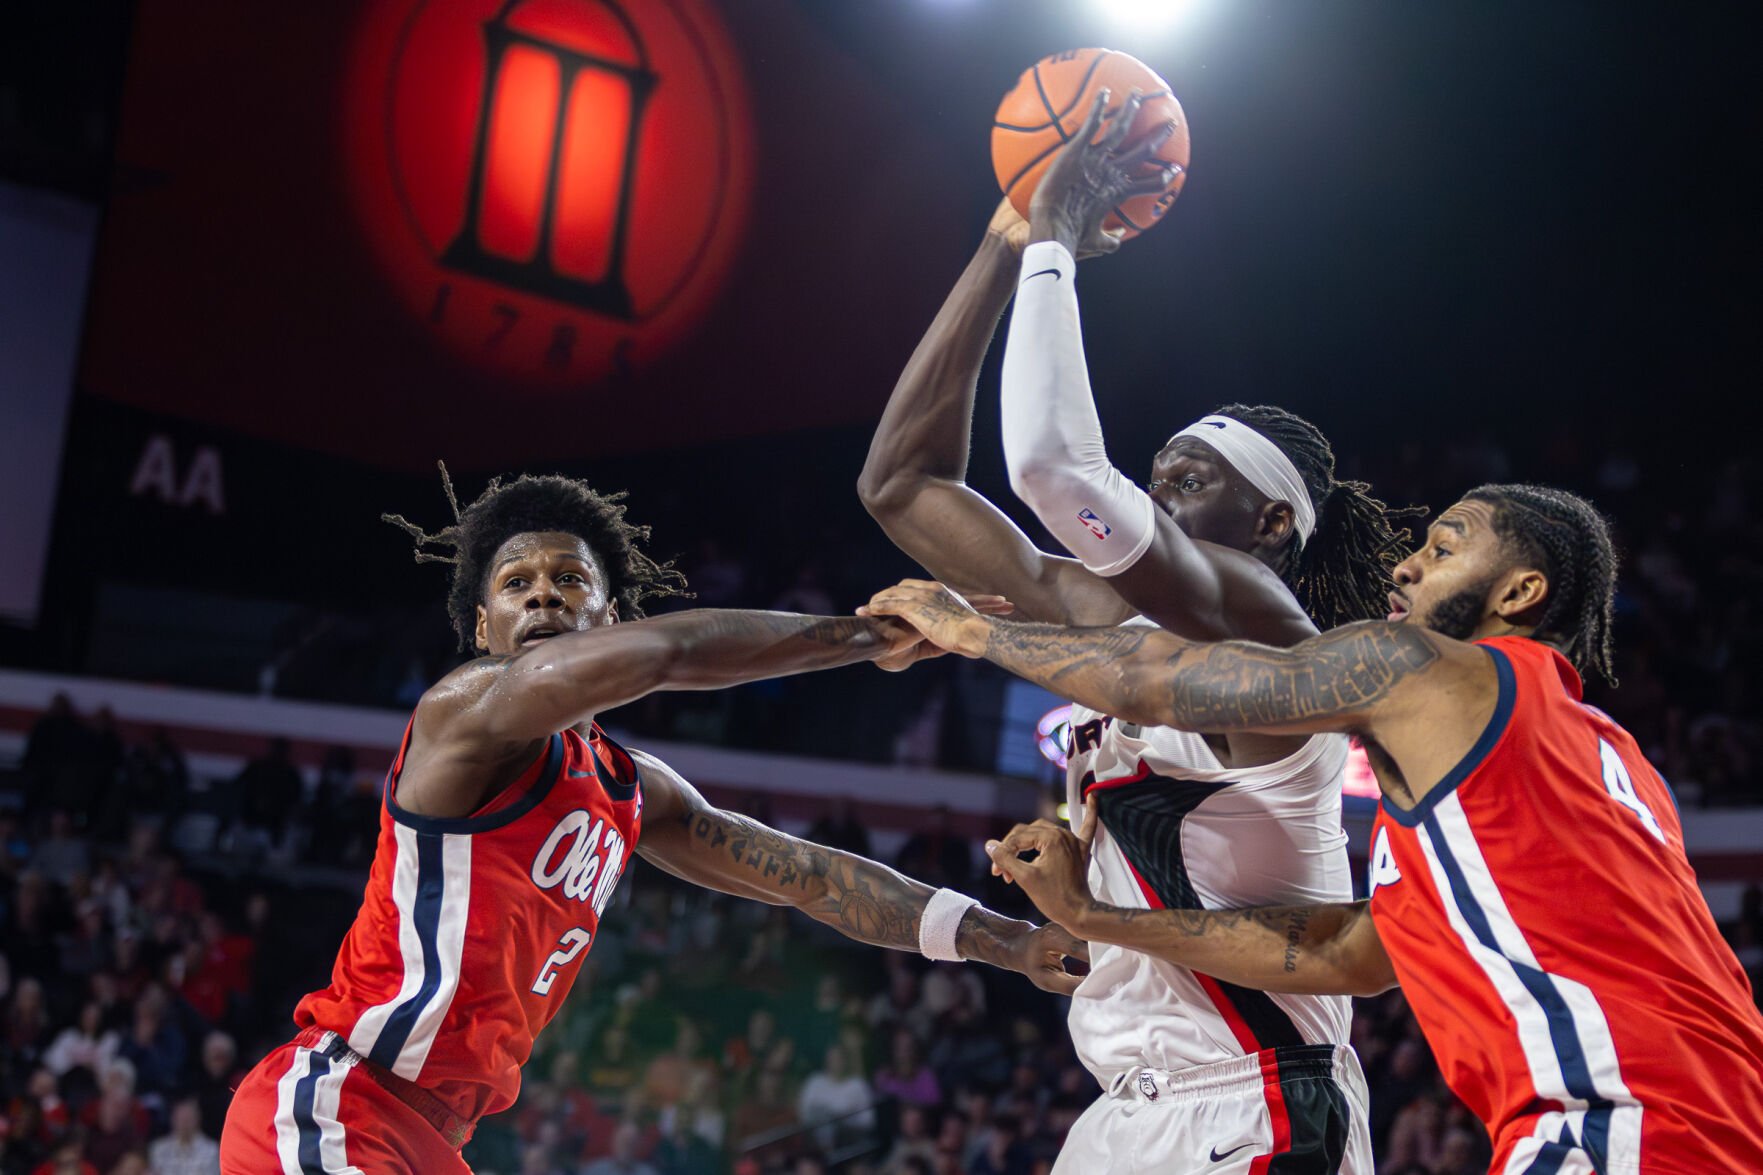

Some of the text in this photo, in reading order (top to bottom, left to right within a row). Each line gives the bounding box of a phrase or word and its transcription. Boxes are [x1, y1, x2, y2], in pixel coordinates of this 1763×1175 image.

[130, 435, 225, 514] AA
[1597, 735, 1667, 846] 4
[530, 807, 604, 903] Ole
[530, 926, 591, 996] 2
